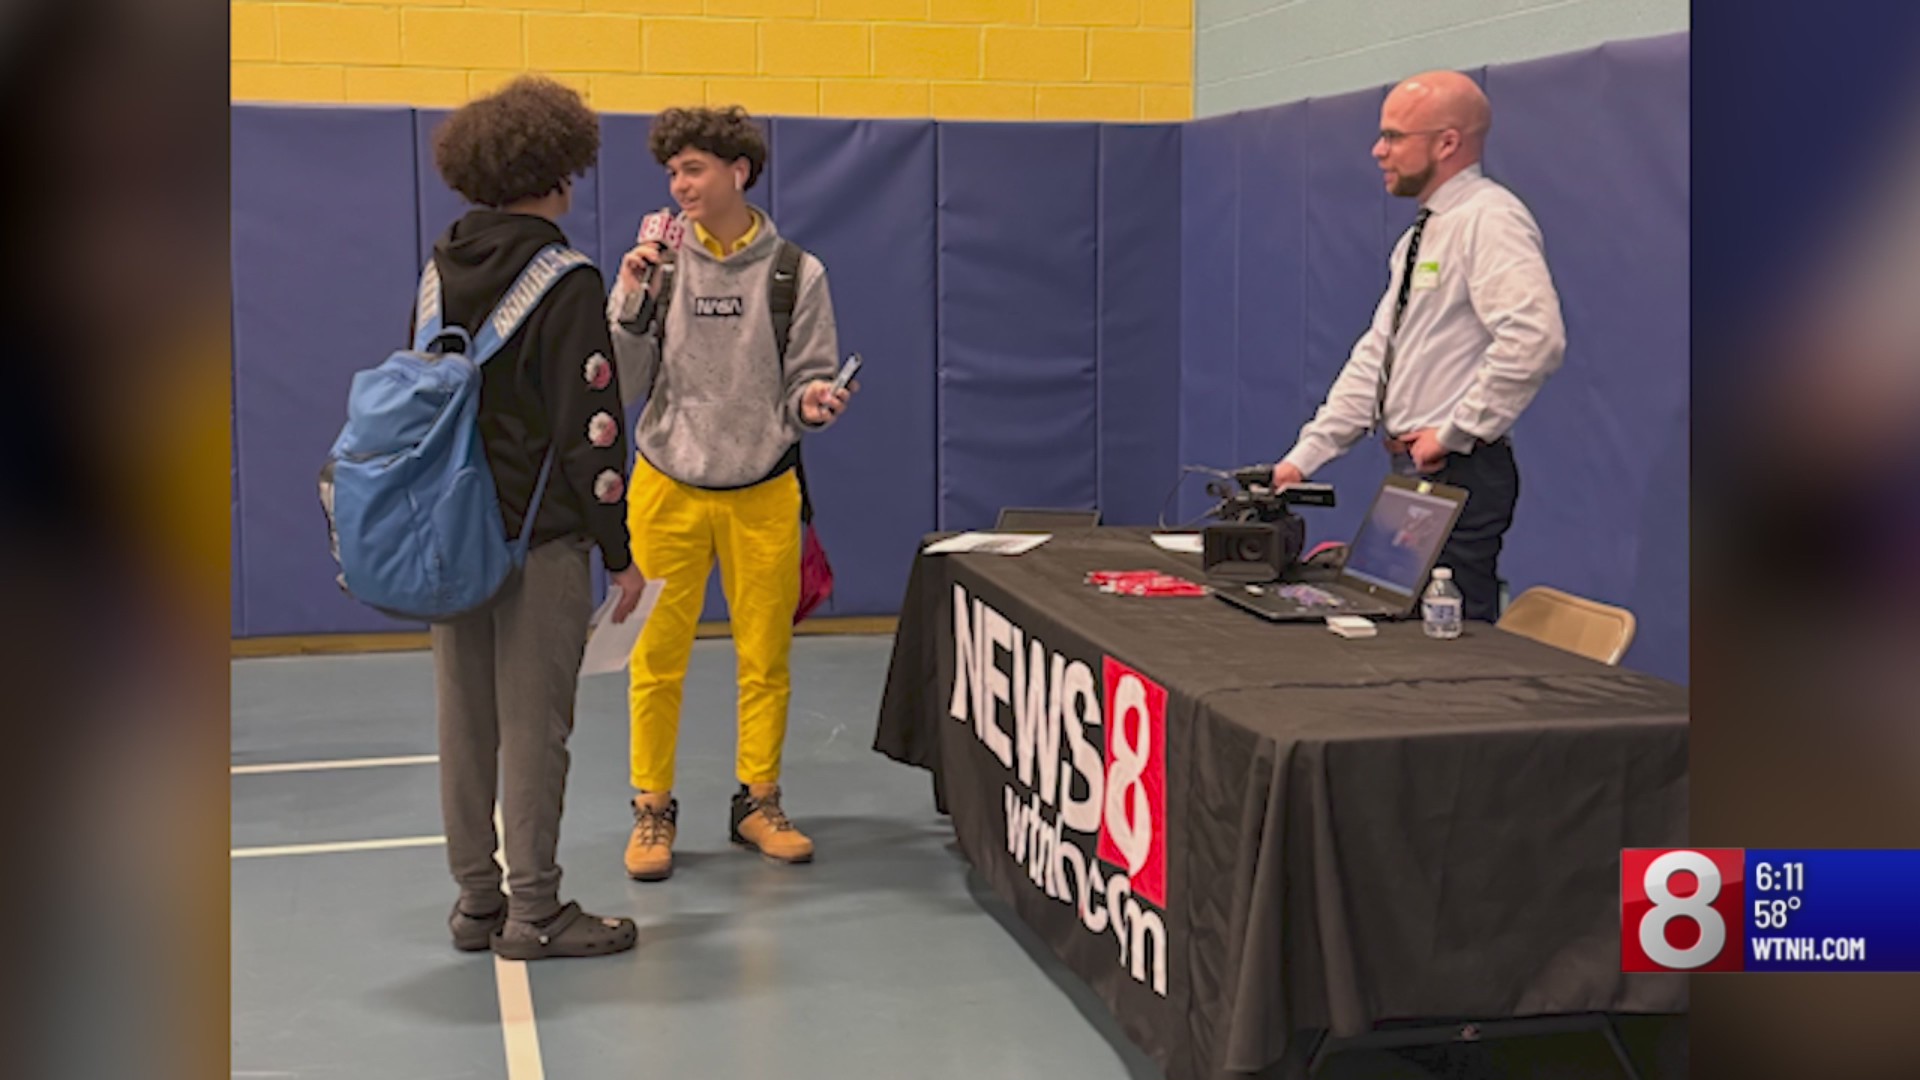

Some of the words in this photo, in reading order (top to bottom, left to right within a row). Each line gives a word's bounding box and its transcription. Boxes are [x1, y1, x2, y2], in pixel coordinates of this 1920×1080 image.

[644, 215, 661, 240] 8
[697, 299, 741, 315] NASA
[951, 582, 1104, 832] NEWS
[1105, 674, 1152, 877] 8
[1005, 784, 1167, 997] wtnhcom
